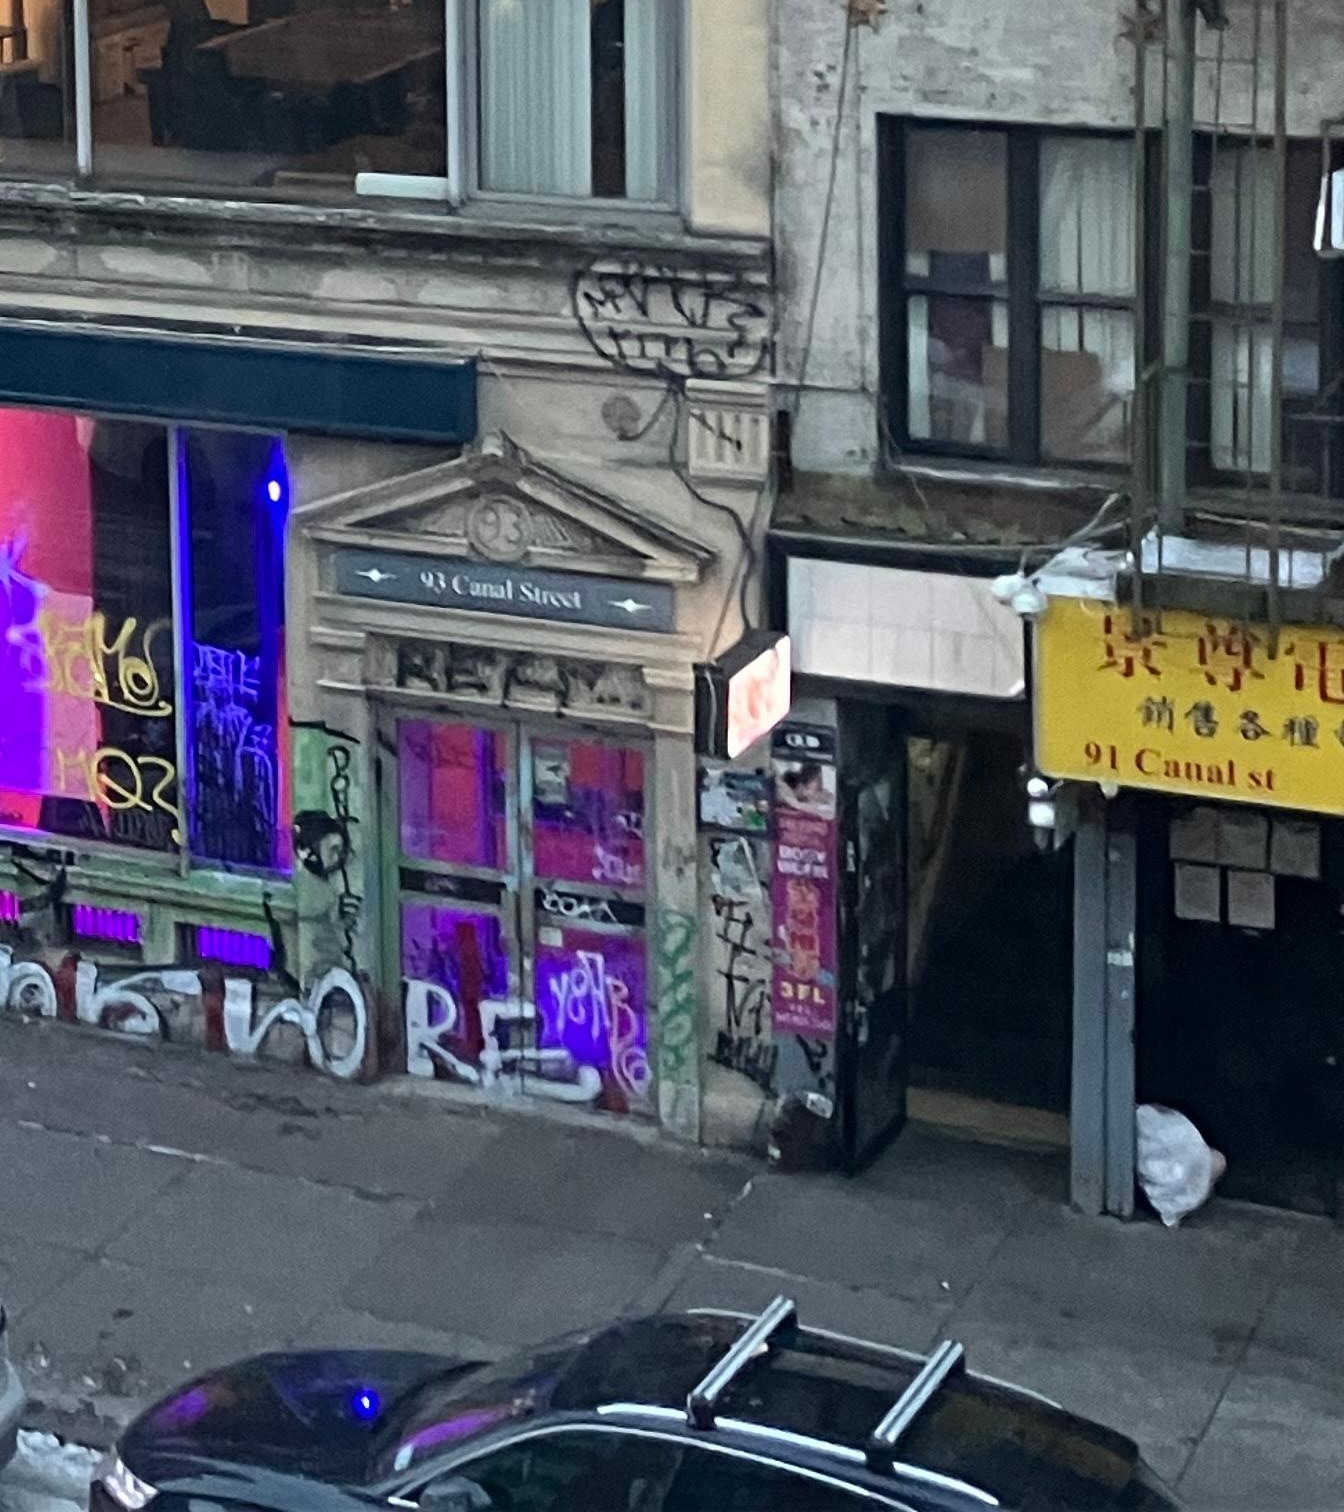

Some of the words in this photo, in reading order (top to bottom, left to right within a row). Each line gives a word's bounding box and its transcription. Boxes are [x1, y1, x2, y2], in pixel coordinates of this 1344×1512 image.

[419, 571, 447, 594] 93
[451, 575, 513, 601] Canal
[518, 583, 582, 610] Street
[1084, 740, 1119, 772] 91
[1134, 748, 1236, 787] Canal
[1248, 767, 1276, 792] st
